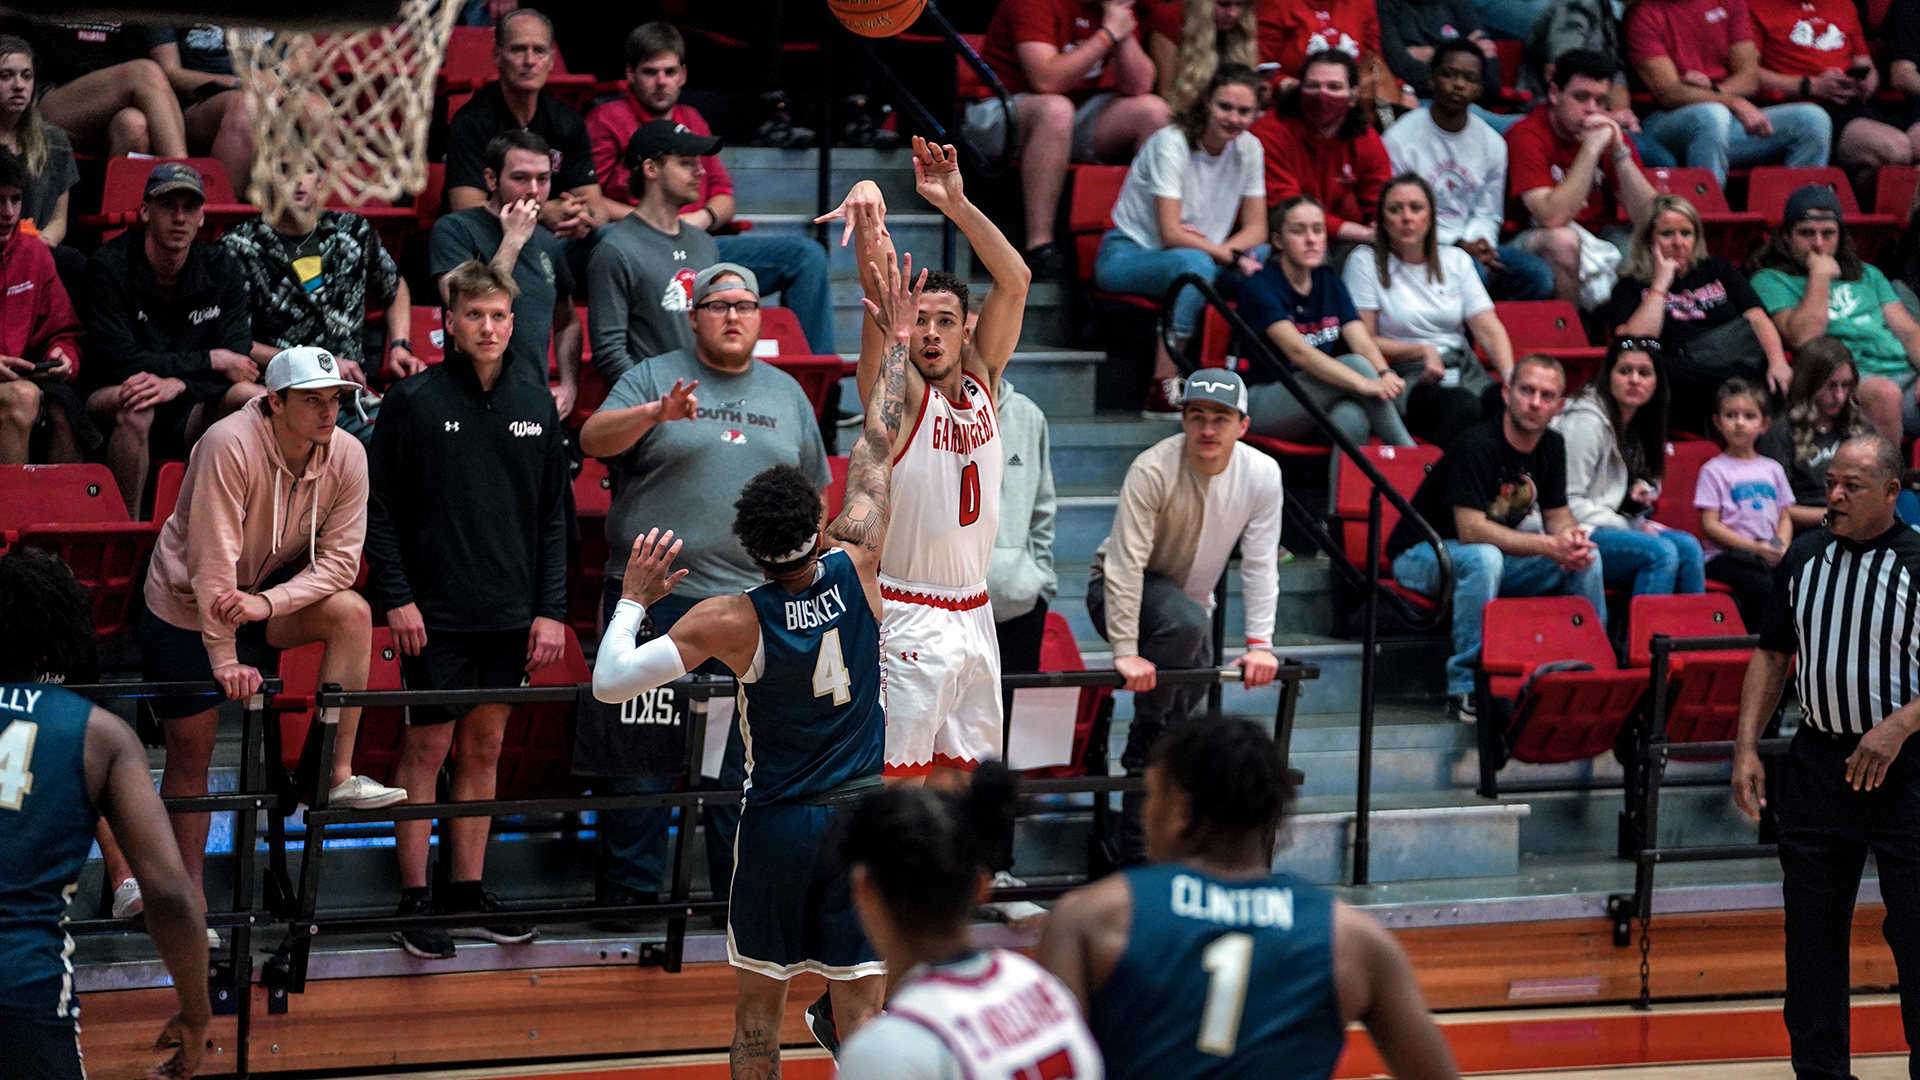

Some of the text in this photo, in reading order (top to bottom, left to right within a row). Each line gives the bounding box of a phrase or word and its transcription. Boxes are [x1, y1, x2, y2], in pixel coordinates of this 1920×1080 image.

[188, 304, 221, 326] Webb
[508, 420, 543, 438] Webb
[695, 407, 778, 429] OUTH DAY
[959, 460, 981, 527] 0
[785, 583, 847, 631] BUSKEY
[812, 627, 851, 707] 4
[1171, 873, 1295, 931] CLINTON
[1196, 930, 1255, 1058] 1
